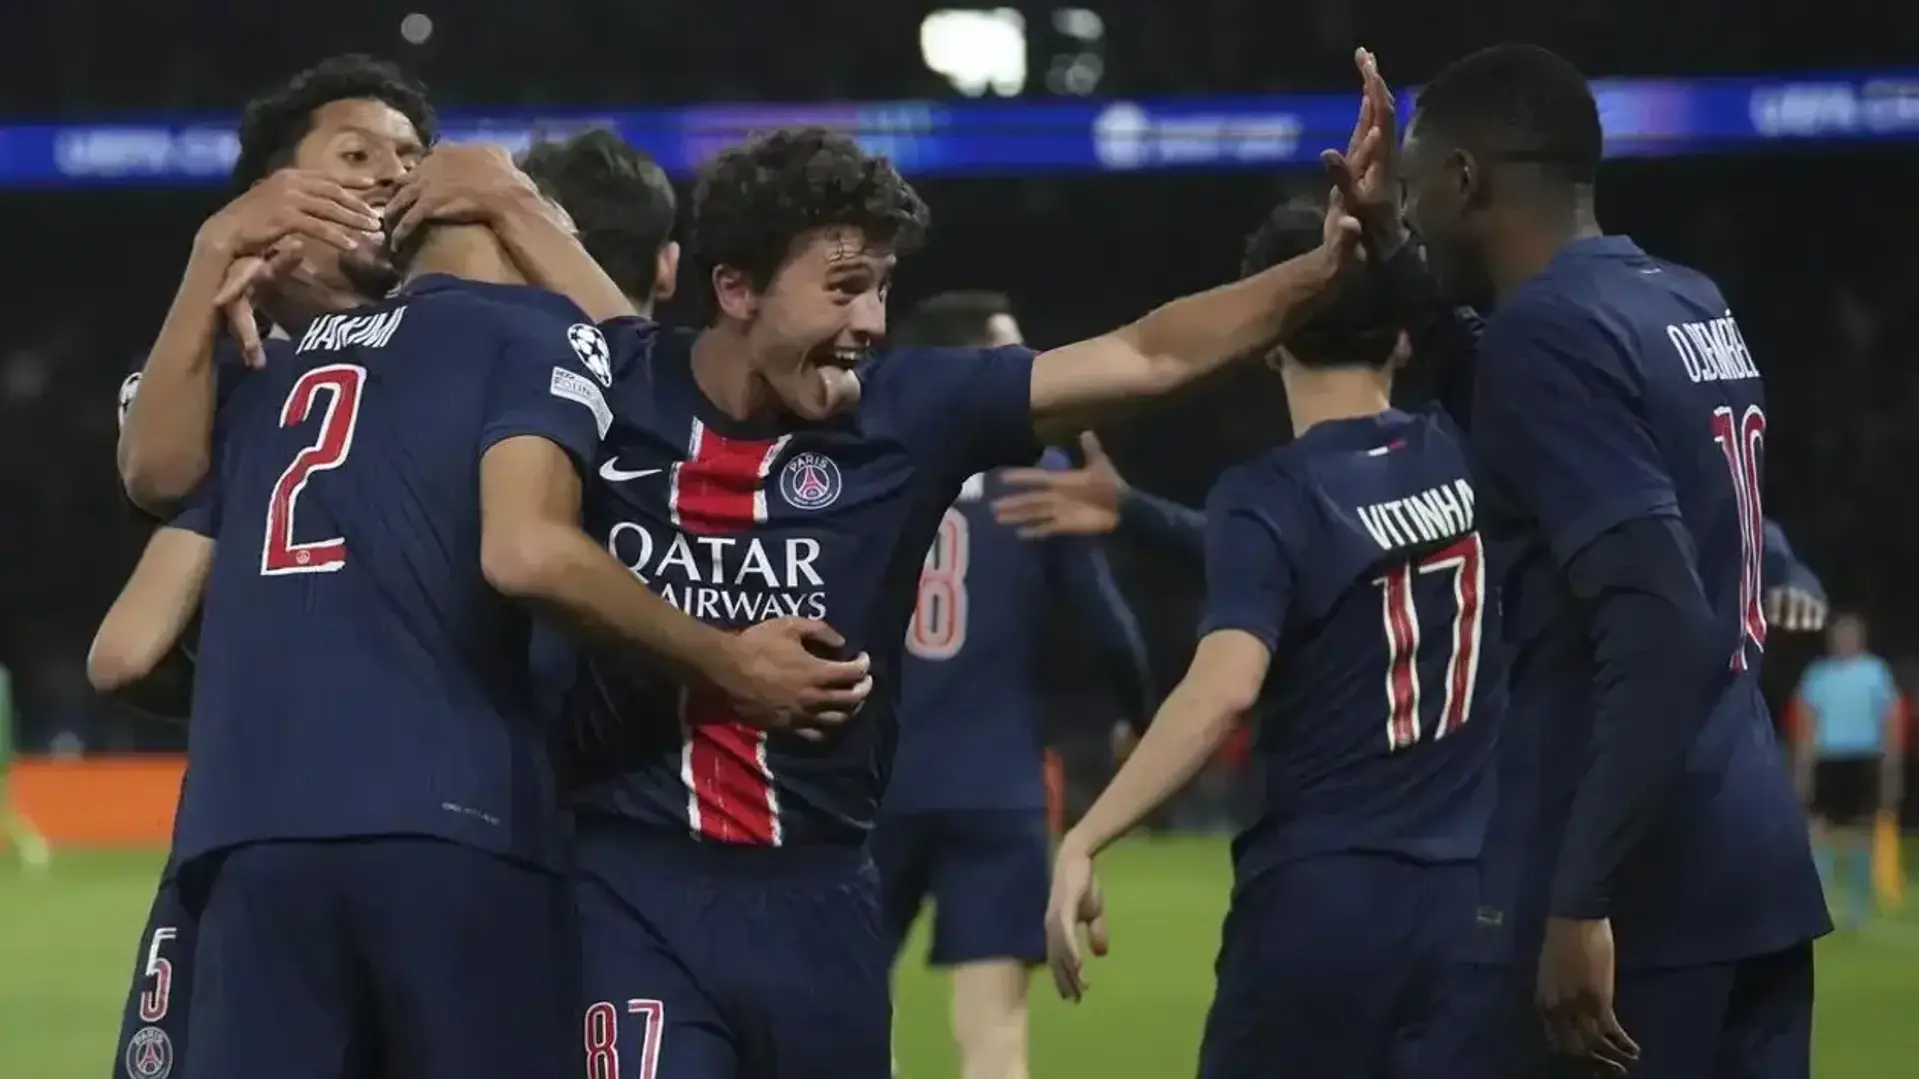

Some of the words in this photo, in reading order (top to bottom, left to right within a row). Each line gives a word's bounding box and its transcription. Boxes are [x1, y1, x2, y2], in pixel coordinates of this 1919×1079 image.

[260, 363, 367, 576] 2
[789, 454, 829, 472] PARIS
[608, 521, 825, 588] QATAR
[905, 506, 969, 661] 8
[1710, 404, 1767, 673] 10
[1371, 531, 1485, 752] 17
[140, 927, 177, 1022] 5
[584, 998, 664, 1079] 87
